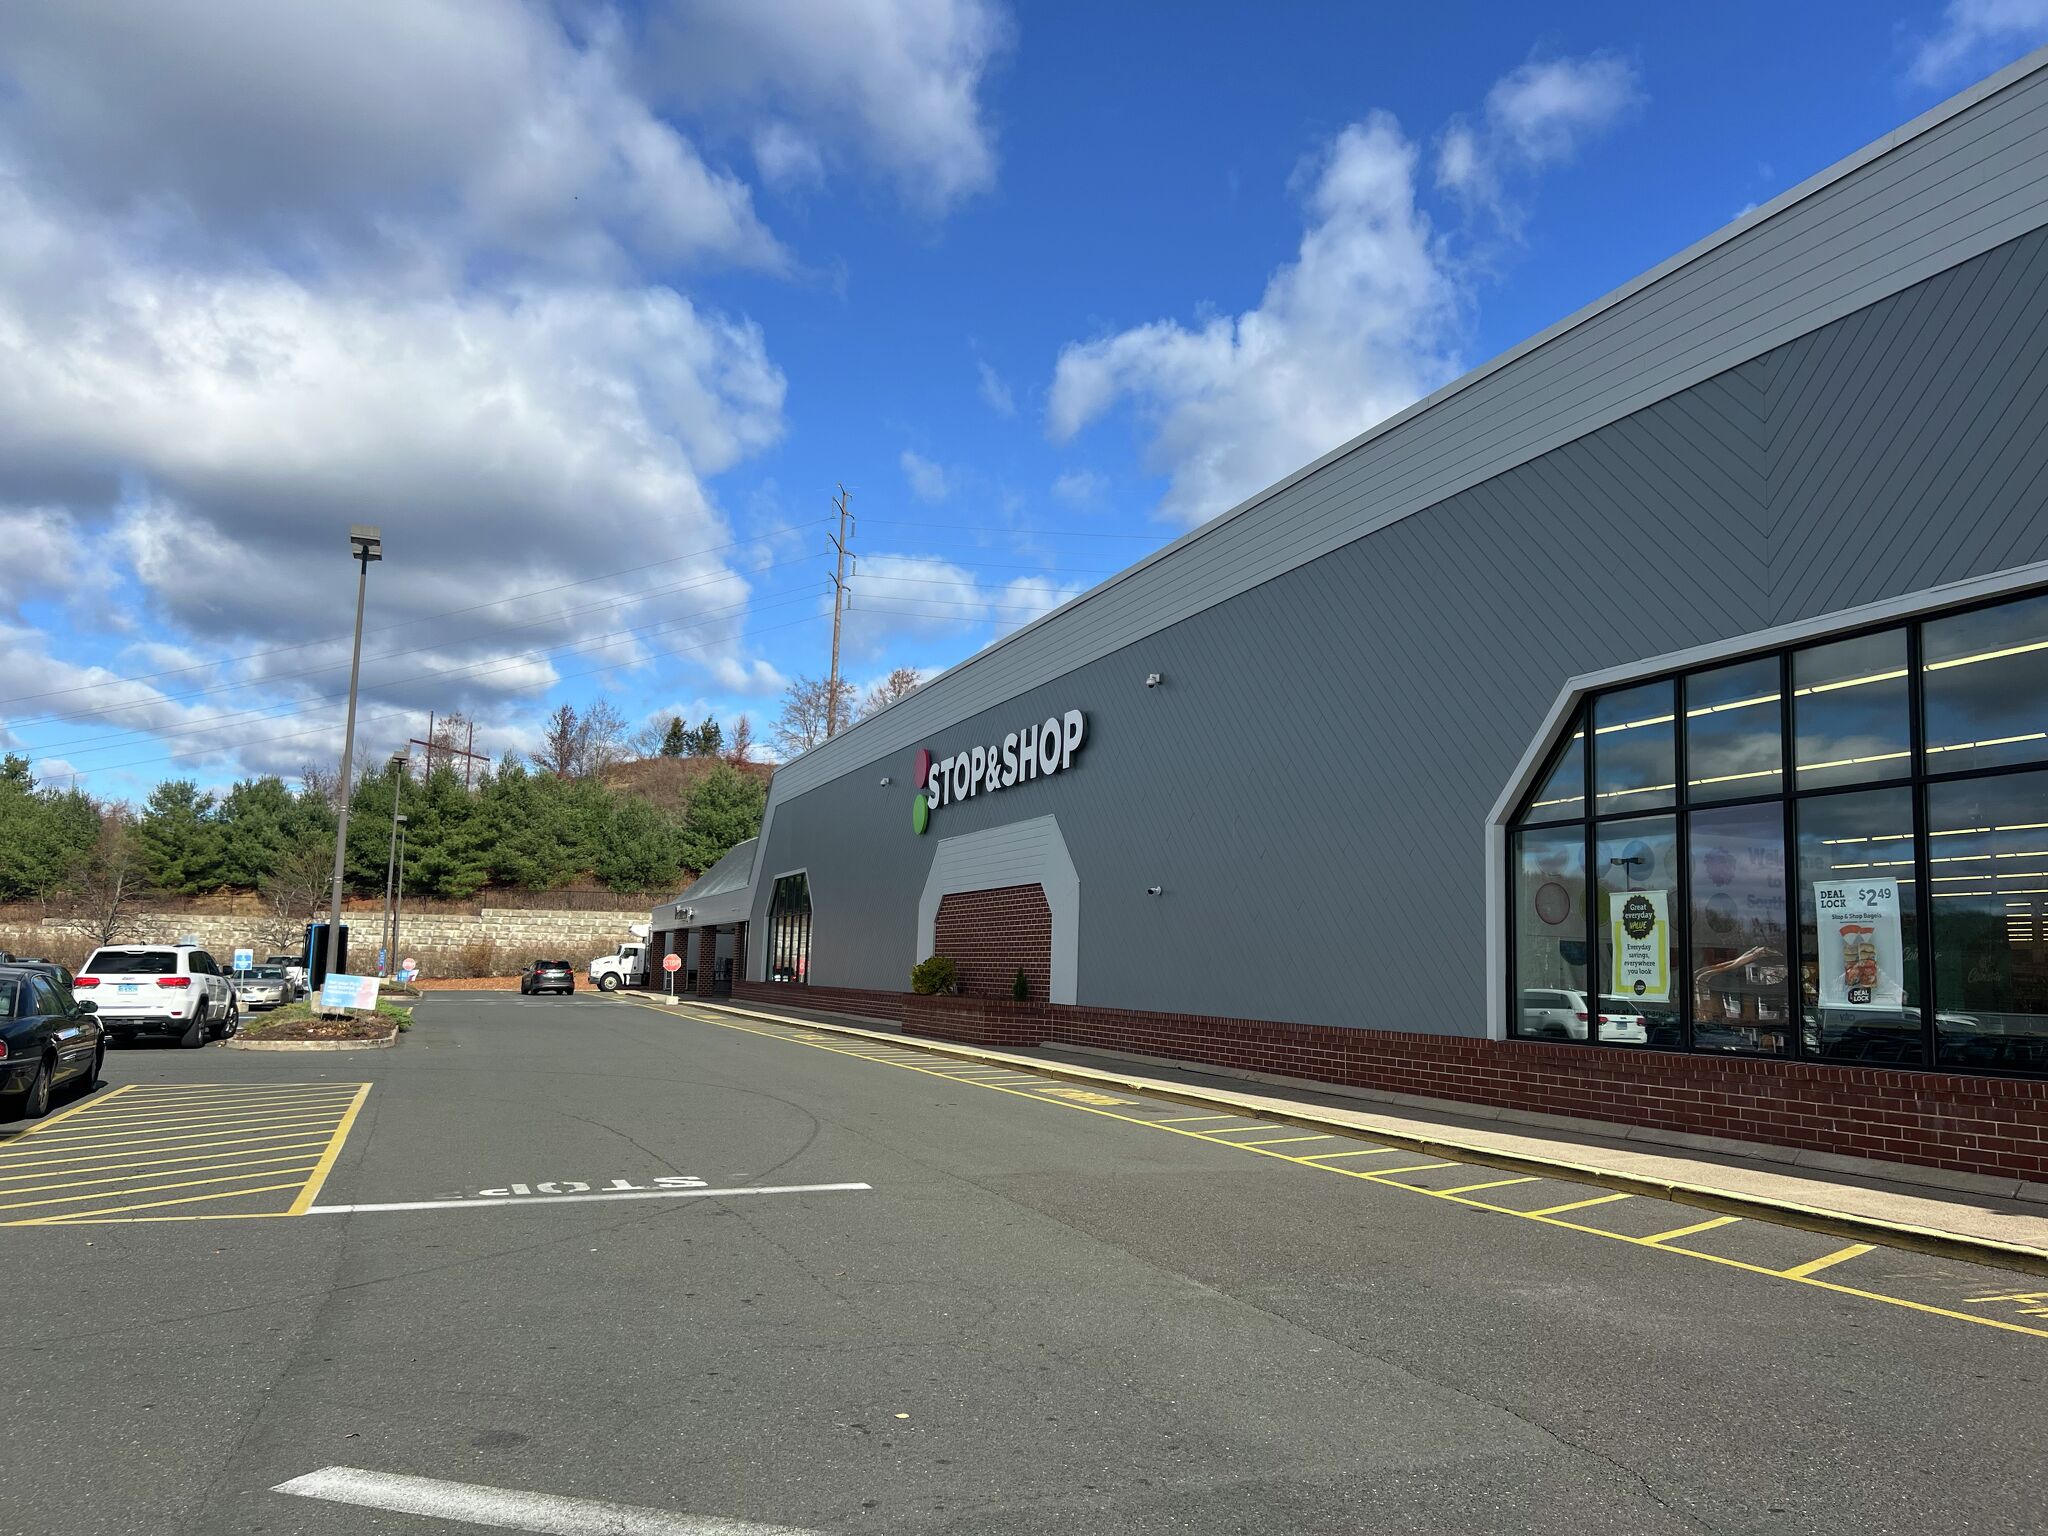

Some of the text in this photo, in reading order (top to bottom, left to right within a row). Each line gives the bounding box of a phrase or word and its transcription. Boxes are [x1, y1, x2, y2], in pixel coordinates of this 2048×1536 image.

[927, 709, 1084, 810] STOP&SHOP
[1820, 889, 1844, 899] DEAL
[1630, 903, 1647, 911] Great
[1821, 899, 1846, 908] LOCK
[1625, 912, 1653, 920] everyday
[1629, 921, 1648, 930] VALUE
[1627, 944, 1651, 952] Everyday
[1629, 952, 1650, 960] savings,
[663, 959, 680, 967] STOP
[479, 1176, 709, 1195] STOP
